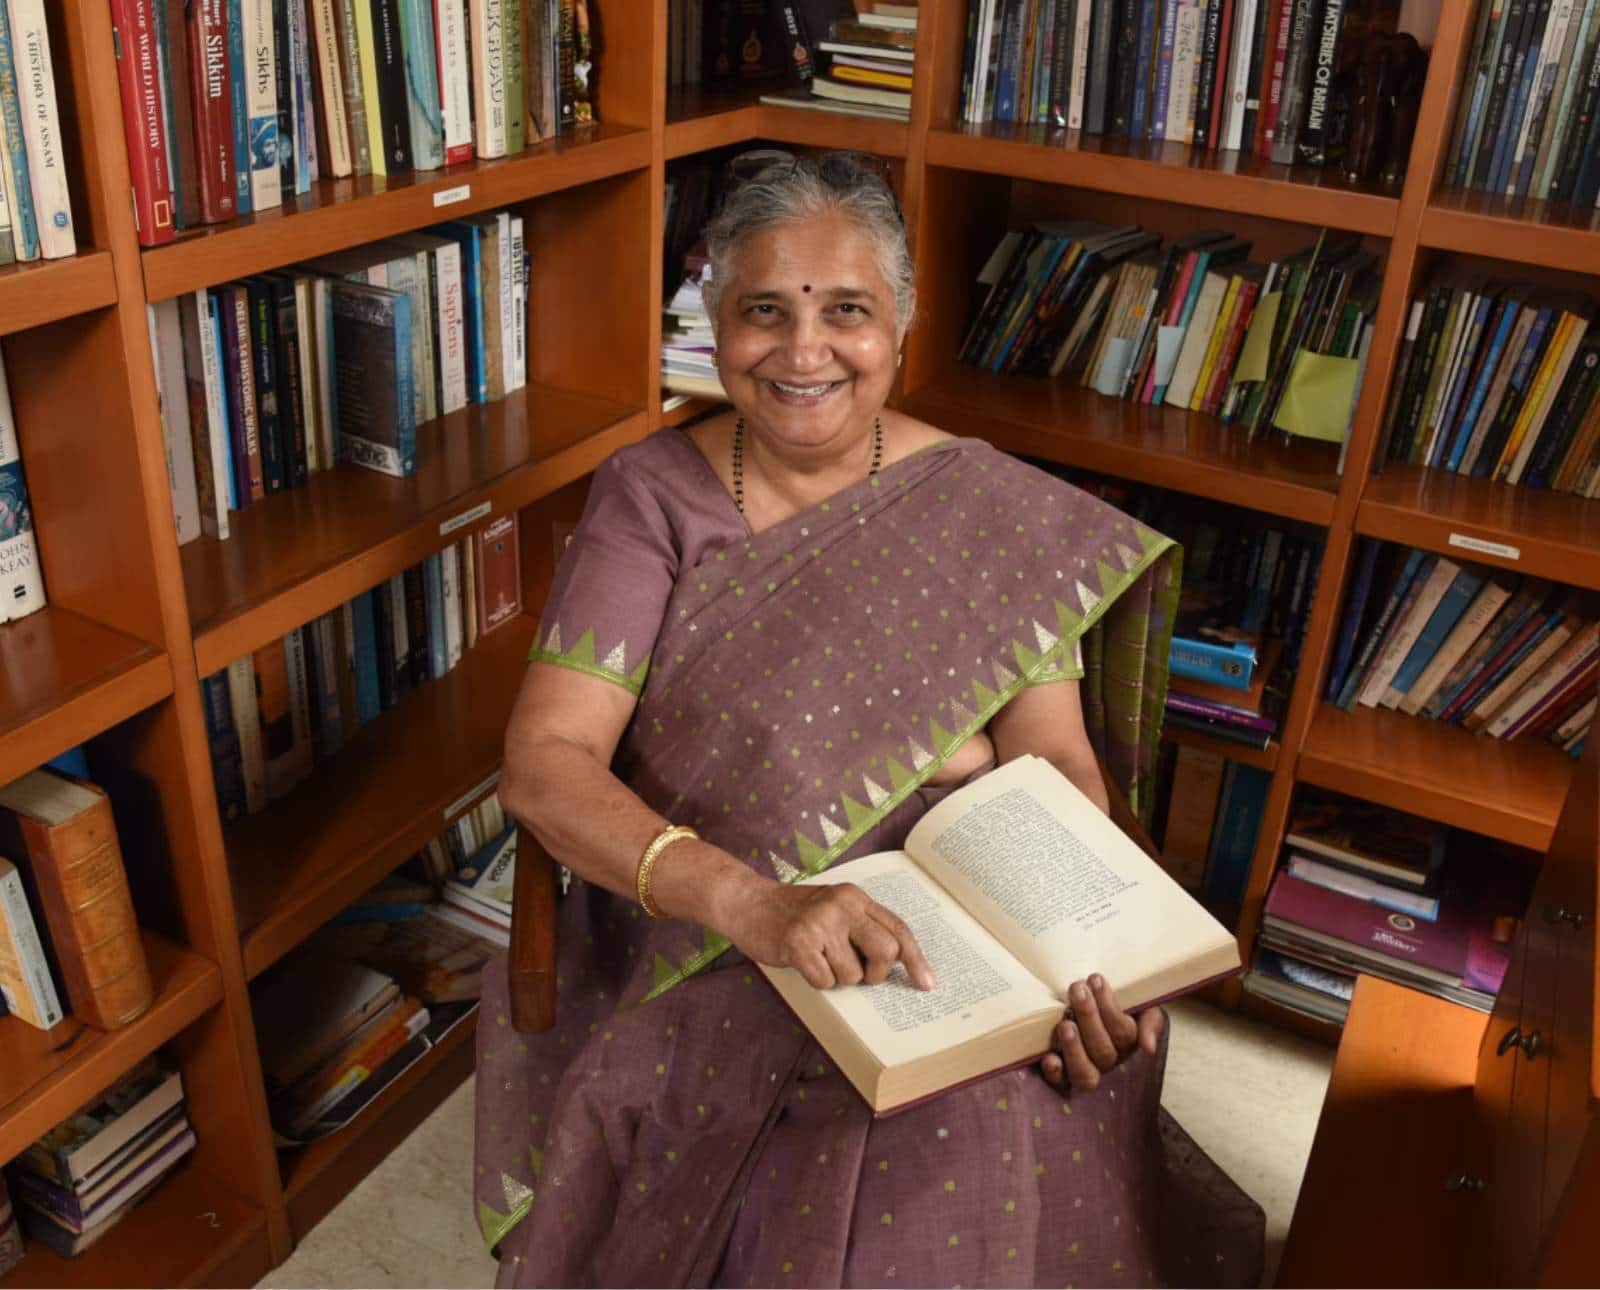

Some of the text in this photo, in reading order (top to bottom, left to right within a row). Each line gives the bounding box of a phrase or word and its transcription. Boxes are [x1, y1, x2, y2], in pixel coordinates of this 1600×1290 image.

[26, 31, 34, 39] A
[137, 15, 146, 27] OF
[26, 40, 43, 99] HISTORY
[139, 34, 153, 85] WORLD
[207, 34, 223, 97] Sikkim
[256, 46, 268, 95] Sikhs
[488, 38, 503, 103] ROAD
[1309, 7, 1341, 131] MYSTERIES OF BRITAIN
[38, 103, 47, 121] OF
[146, 89, 159, 148] HISTORY
[40, 126, 54, 168] ASSAM
[513, 235, 523, 286] JUSTICE
[443, 281, 459, 359] Sapiens
[240, 342, 248, 357] 14
[241, 357, 253, 415] HISTORIC
[245, 414, 257, 456] WALKS
[0, 555, 32, 574] KEAY
